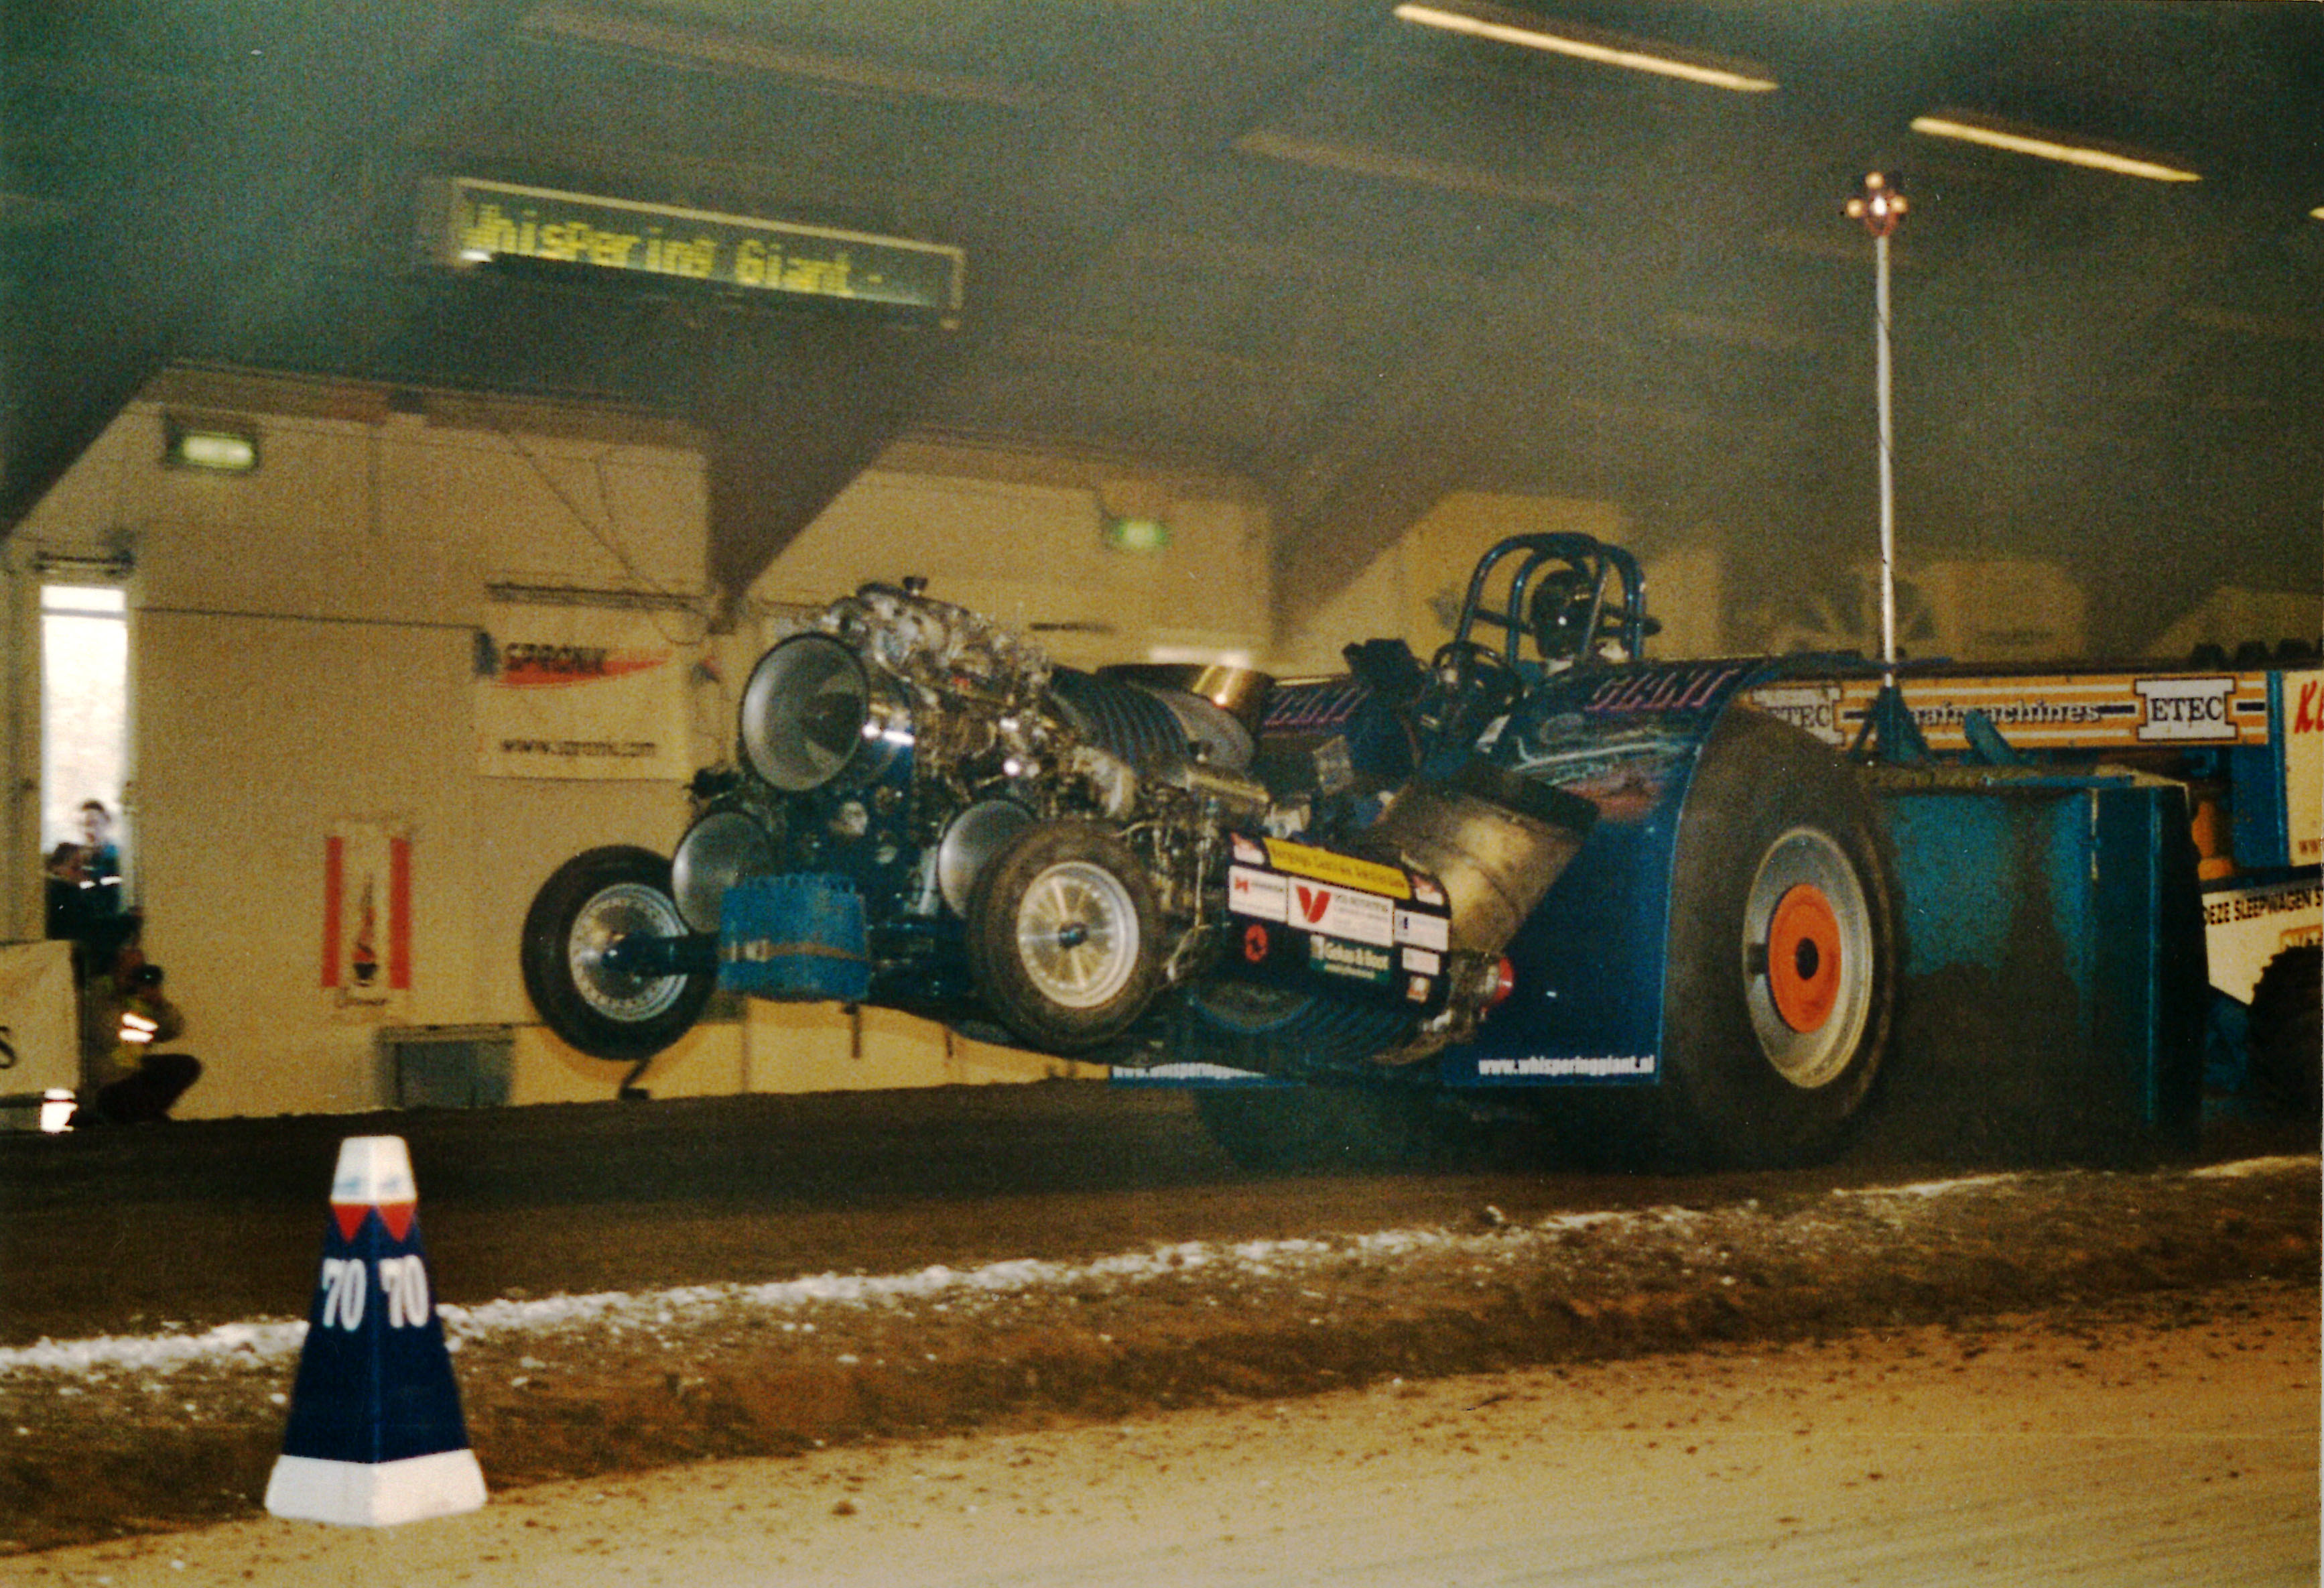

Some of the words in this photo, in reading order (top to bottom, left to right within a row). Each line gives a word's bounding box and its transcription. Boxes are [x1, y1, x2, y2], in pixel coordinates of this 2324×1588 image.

[1769, 704, 1830, 727] TEC
[2150, 696, 2223, 721] ETEC
[322, 1258, 367, 1331] 70
[379, 1254, 429, 1328] 70
